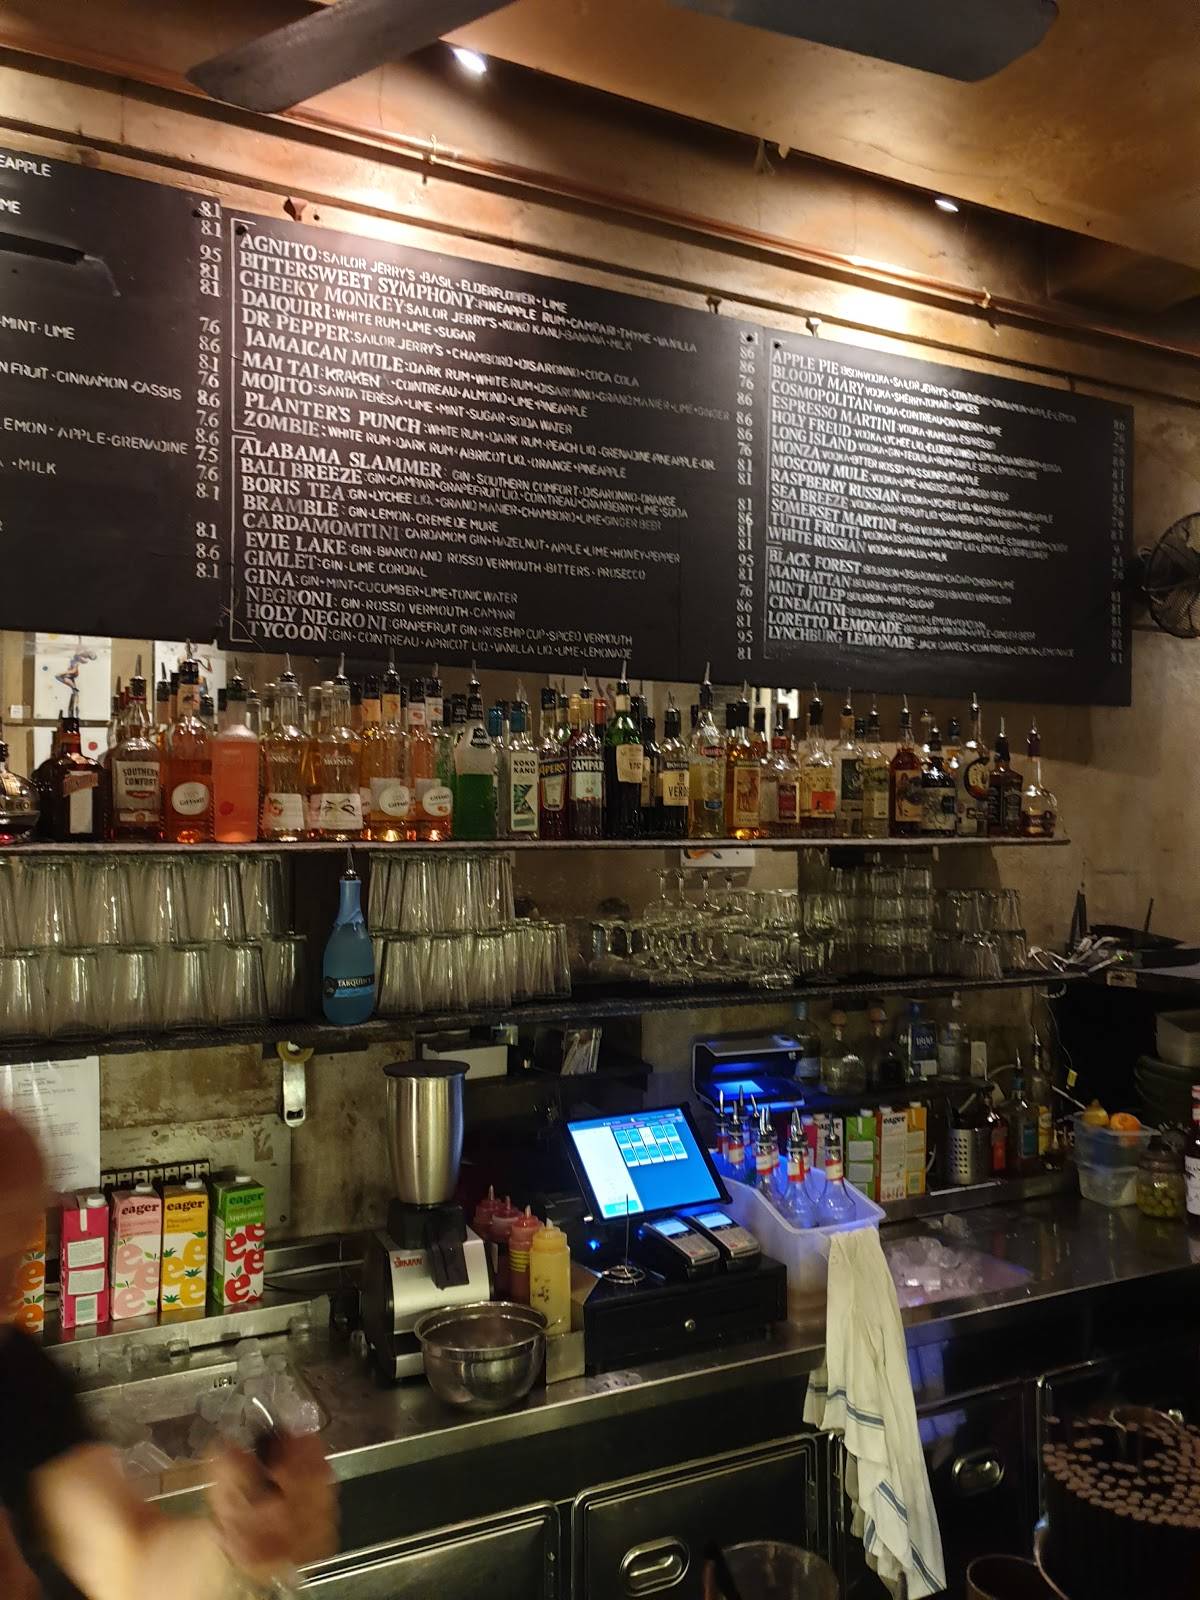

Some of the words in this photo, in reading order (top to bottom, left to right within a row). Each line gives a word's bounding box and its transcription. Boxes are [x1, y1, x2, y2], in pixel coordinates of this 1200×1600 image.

[240, 251, 372, 290] BITTERSWEET
[323, 251, 367, 270] SAILOR
[240, 270, 319, 299] CHEEKY
[241, 308, 270, 328] DR
[44, 324, 76, 340] LIME
[374, 316, 400, 330] RUM
[406, 322, 432, 336] LIME
[437, 326, 476, 342] SUGAR
[245, 327, 347, 364] JAMAICAN
[444, 367, 470, 382] RUM
[772, 350, 815, 371] APPLE
[242, 351, 282, 373] MAI
[325, 366, 380, 388] KRAKEN
[772, 364, 824, 388] BLOODY
[11, 362, 48, 380] FRUIT
[56, 370, 129, 390] CINNAMON
[134, 381, 182, 400] CASSIS
[318, 385, 358, 400] SANTA
[360, 390, 403, 406] TERESA
[244, 392, 351, 423] PLANTER'S
[772, 394, 837, 420] ESPRESSO
[772, 410, 806, 428] HOLY
[0, 417, 48, 435] EMON
[58, 428, 106, 445] APPLE
[111, 436, 188, 455] GRENADINE
[772, 424, 806, 445] LONG
[239, 439, 341, 466] ALABAMA
[18, 458, 56, 476] MILK
[240, 457, 286, 478] BALI
[771, 454, 830, 475] MOSCOW
[241, 475, 300, 496] BORIS
[770, 468, 846, 494] RASPBERRY
[771, 482, 797, 500] SEA
[771, 498, 840, 522] SOMERSET
[770, 512, 810, 531] TUTTI
[245, 532, 290, 550] EVIE
[768, 526, 812, 546] WHITE
[768, 550, 810, 568] BLACK
[768, 580, 804, 596] MINT
[246, 603, 300, 622] HOLY
[341, 598, 360, 608] GIN
[768, 611, 828, 628] LORETTO
[768, 626, 844, 644] LYNCHBURG
[884, 1116, 906, 1125] eager
[166, 1200, 204, 1212] eager
[228, 1192, 264, 1205] eager
[122, 1204, 160, 1216] eager
